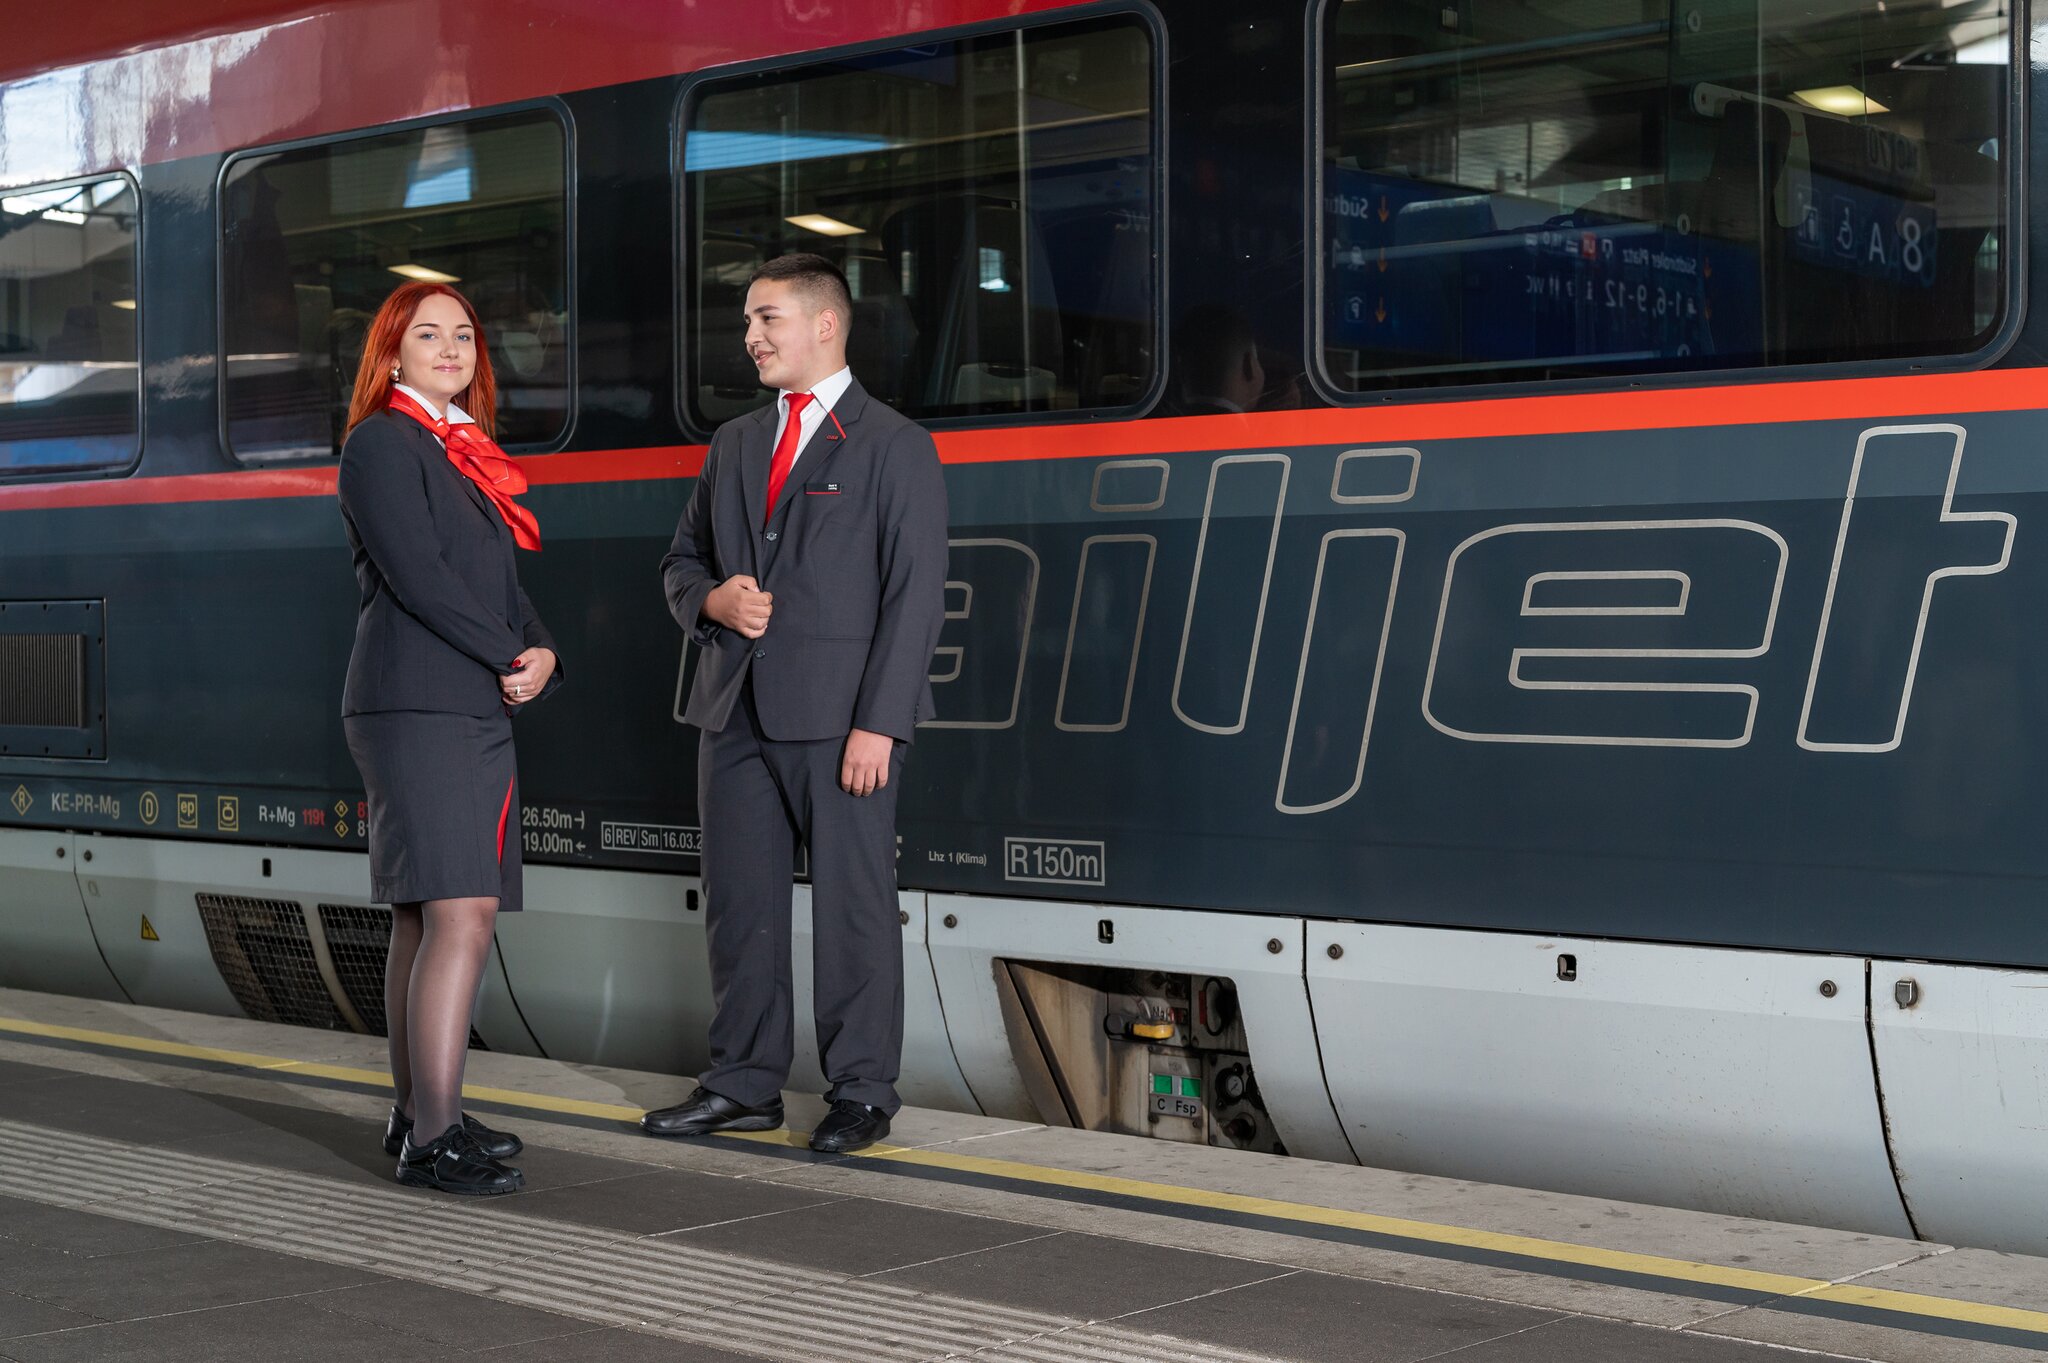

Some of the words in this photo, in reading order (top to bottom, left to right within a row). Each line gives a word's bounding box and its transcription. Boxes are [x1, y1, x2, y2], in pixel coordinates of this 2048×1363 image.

[51, 793, 121, 819] KE-PR-Mg
[180, 801, 195, 818] ep
[259, 805, 296, 828] R+Mg
[522, 806, 572, 830] 26.50m
[522, 832, 574, 854] 19.00m
[604, 828, 612, 844] 6
[616, 829, 637, 846] REV
[641, 830, 659, 847] Sm
[928, 850, 945, 862] Lhz
[956, 852, 987, 867] (Klima)
[1157, 1098, 1166, 1110] C
[1176, 1099, 1197, 1116] Fsp
